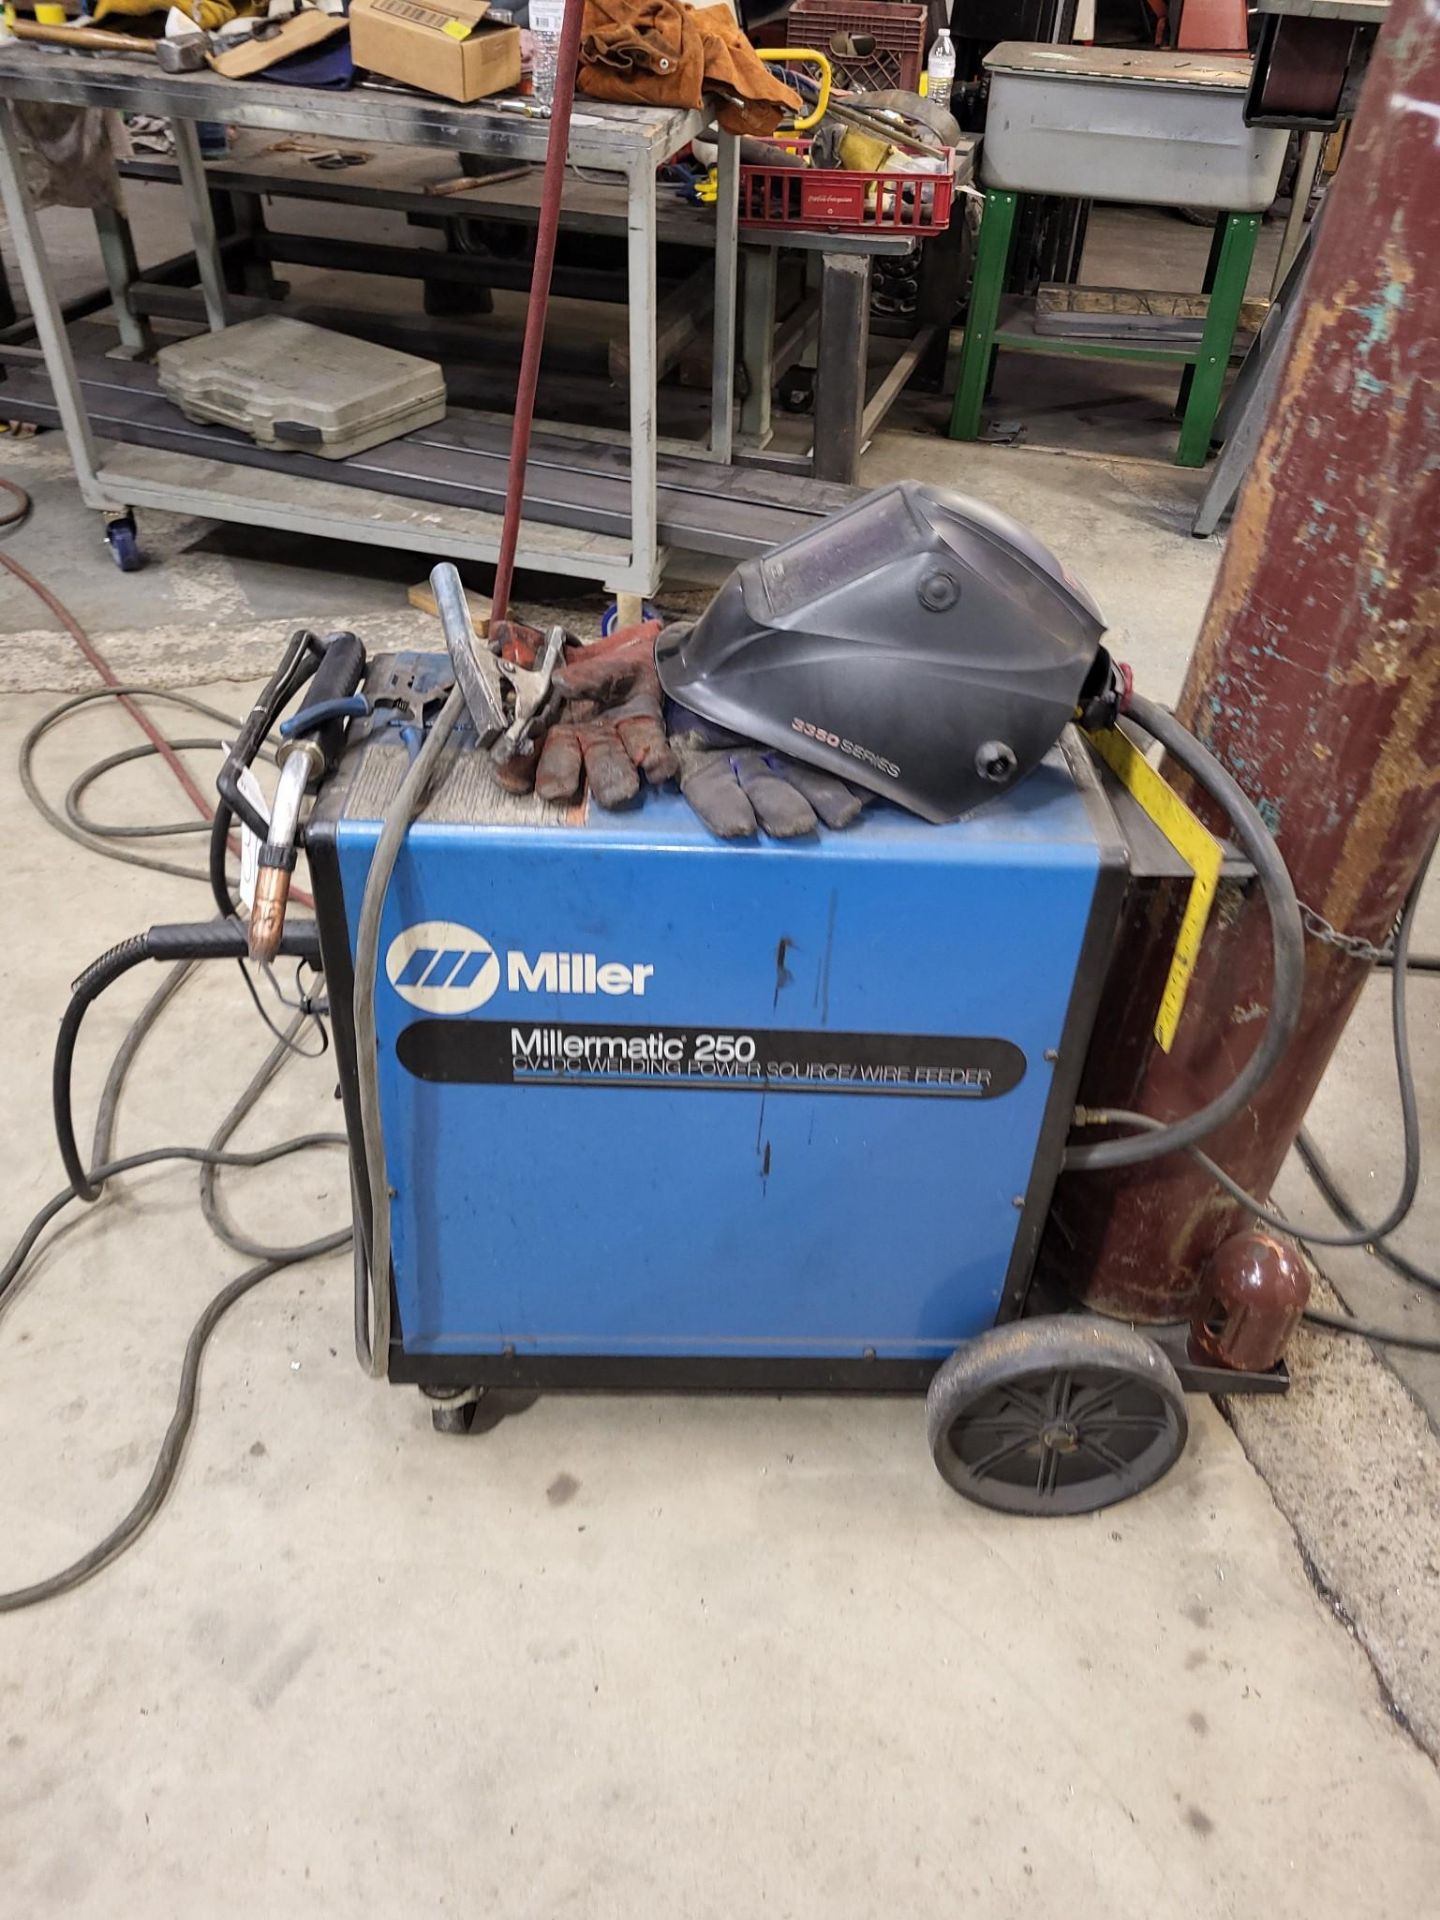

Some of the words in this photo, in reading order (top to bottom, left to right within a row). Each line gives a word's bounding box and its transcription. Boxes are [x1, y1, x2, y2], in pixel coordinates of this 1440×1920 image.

[840, 739, 901, 778] SERIES
[507, 951, 654, 996] Miller
[511, 1027, 686, 1060] Millermatic
[693, 1034, 756, 1063] 250
[588, 1057, 681, 1076] WELDING
[688, 1060, 761, 1080] POWER
[914, 1066, 992, 1088] FEEDER
